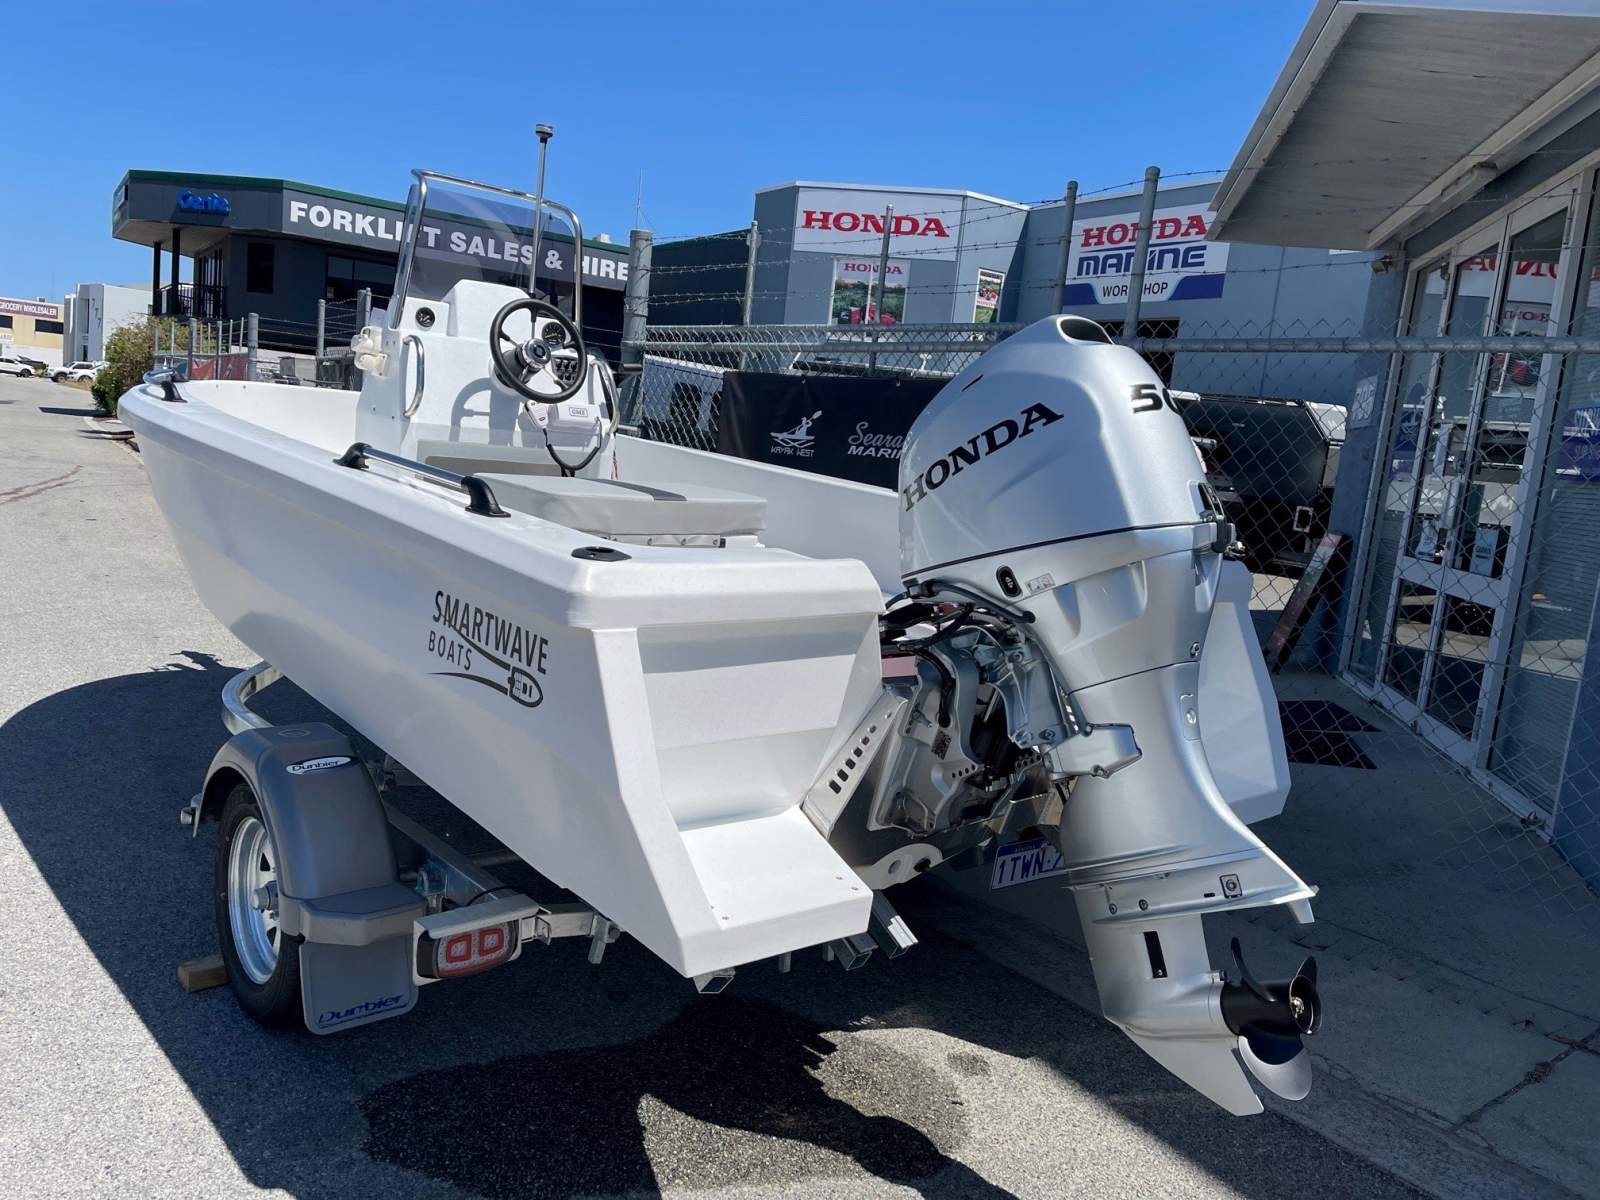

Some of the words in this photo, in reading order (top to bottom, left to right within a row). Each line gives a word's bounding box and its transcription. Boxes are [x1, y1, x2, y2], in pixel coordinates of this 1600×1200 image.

[289, 200, 441, 248] FORKLIT
[450, 231, 535, 265] SALES
[544, 250, 564, 271] &
[801, 210, 950, 238] HONDA
[1102, 281, 1169, 298] WORHOP
[23, 304, 57, 317] WHOLESALER
[903, 402, 1065, 512] HONDA
[428, 630, 472, 671] BOATS
[432, 590, 549, 675] SMARTWAVE
[318, 994, 404, 1025] Dunbier
